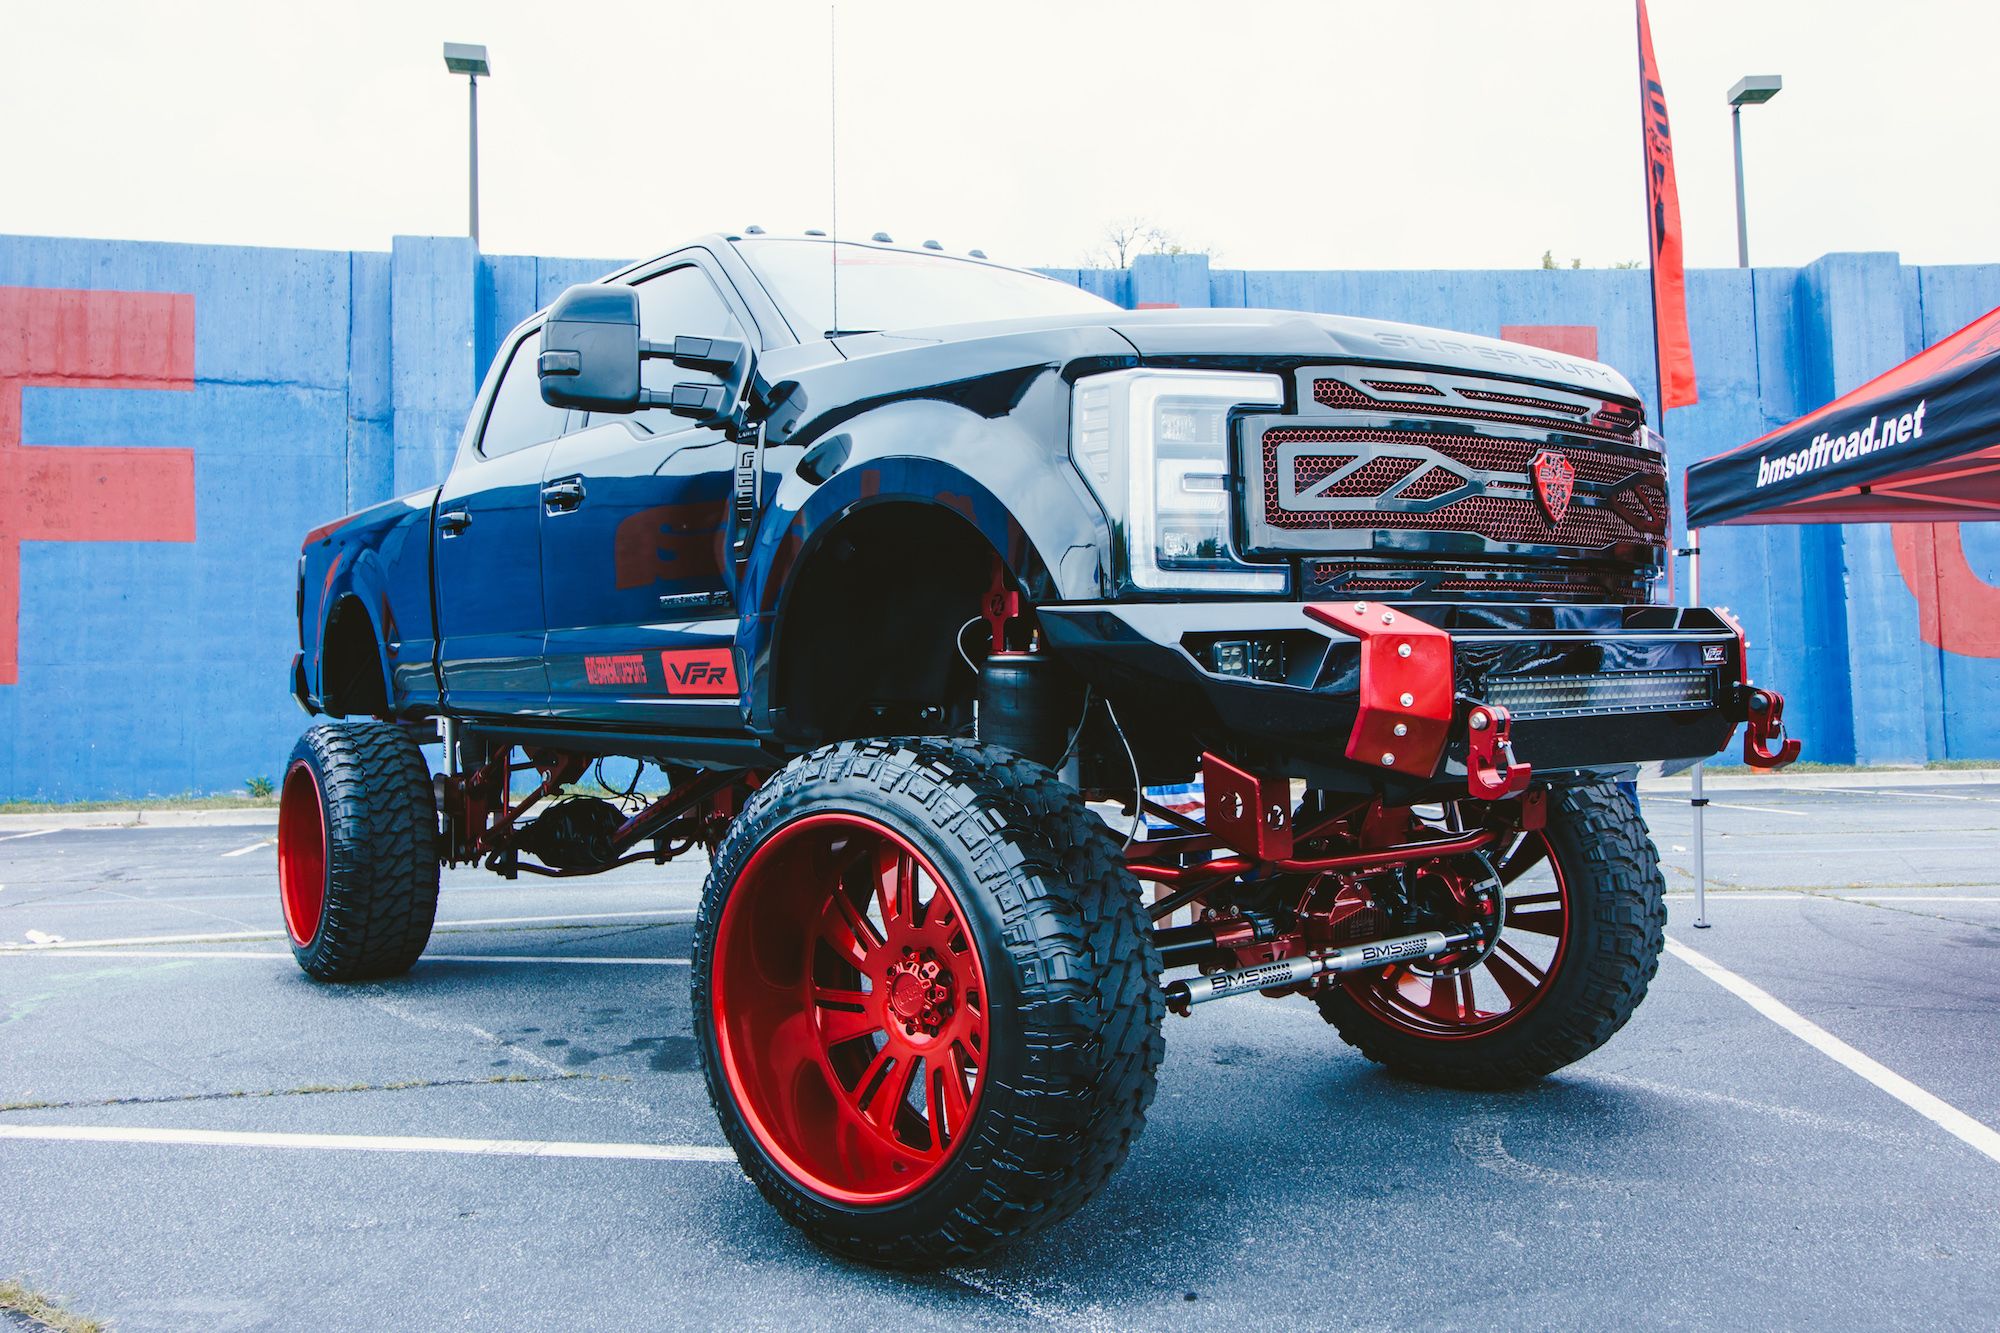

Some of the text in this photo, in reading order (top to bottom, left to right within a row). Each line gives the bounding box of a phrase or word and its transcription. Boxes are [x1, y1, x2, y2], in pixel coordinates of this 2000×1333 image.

[1374, 332, 1612, 383] SUPER DUTY
[1756, 399, 1926, 489] bmsoffroad.net
[1361, 943, 1403, 960] BMS
[1210, 969, 1260, 990] BMS
